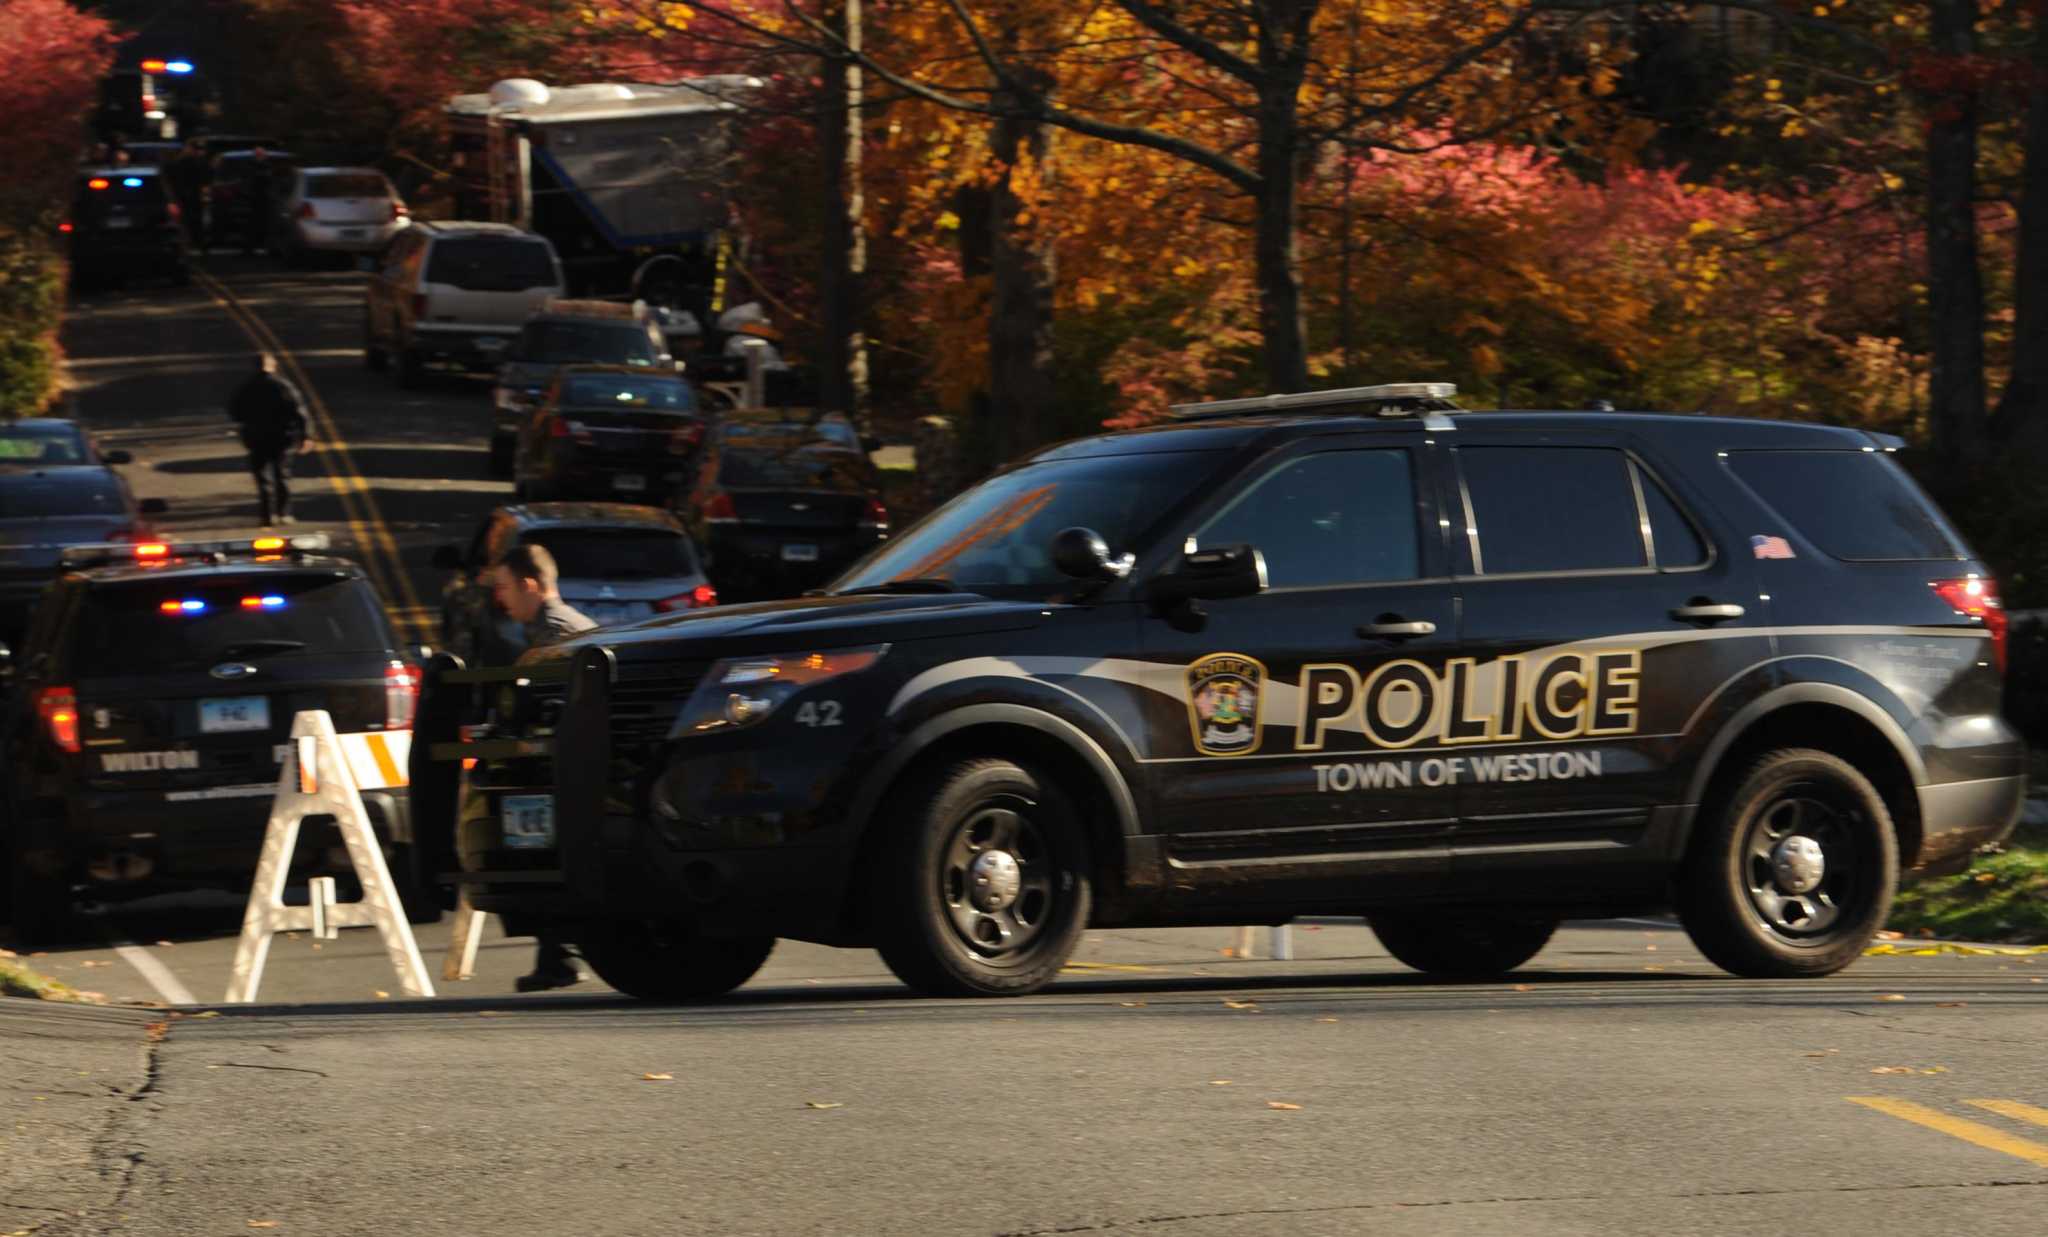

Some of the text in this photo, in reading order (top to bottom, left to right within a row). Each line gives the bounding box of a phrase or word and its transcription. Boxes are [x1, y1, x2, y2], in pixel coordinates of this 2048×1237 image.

[794, 700, 845, 728] 42
[1295, 649, 1642, 750] POLICE
[101, 751, 198, 772] WILTON
[1313, 751, 1603, 792] TOWN OF WESTON
